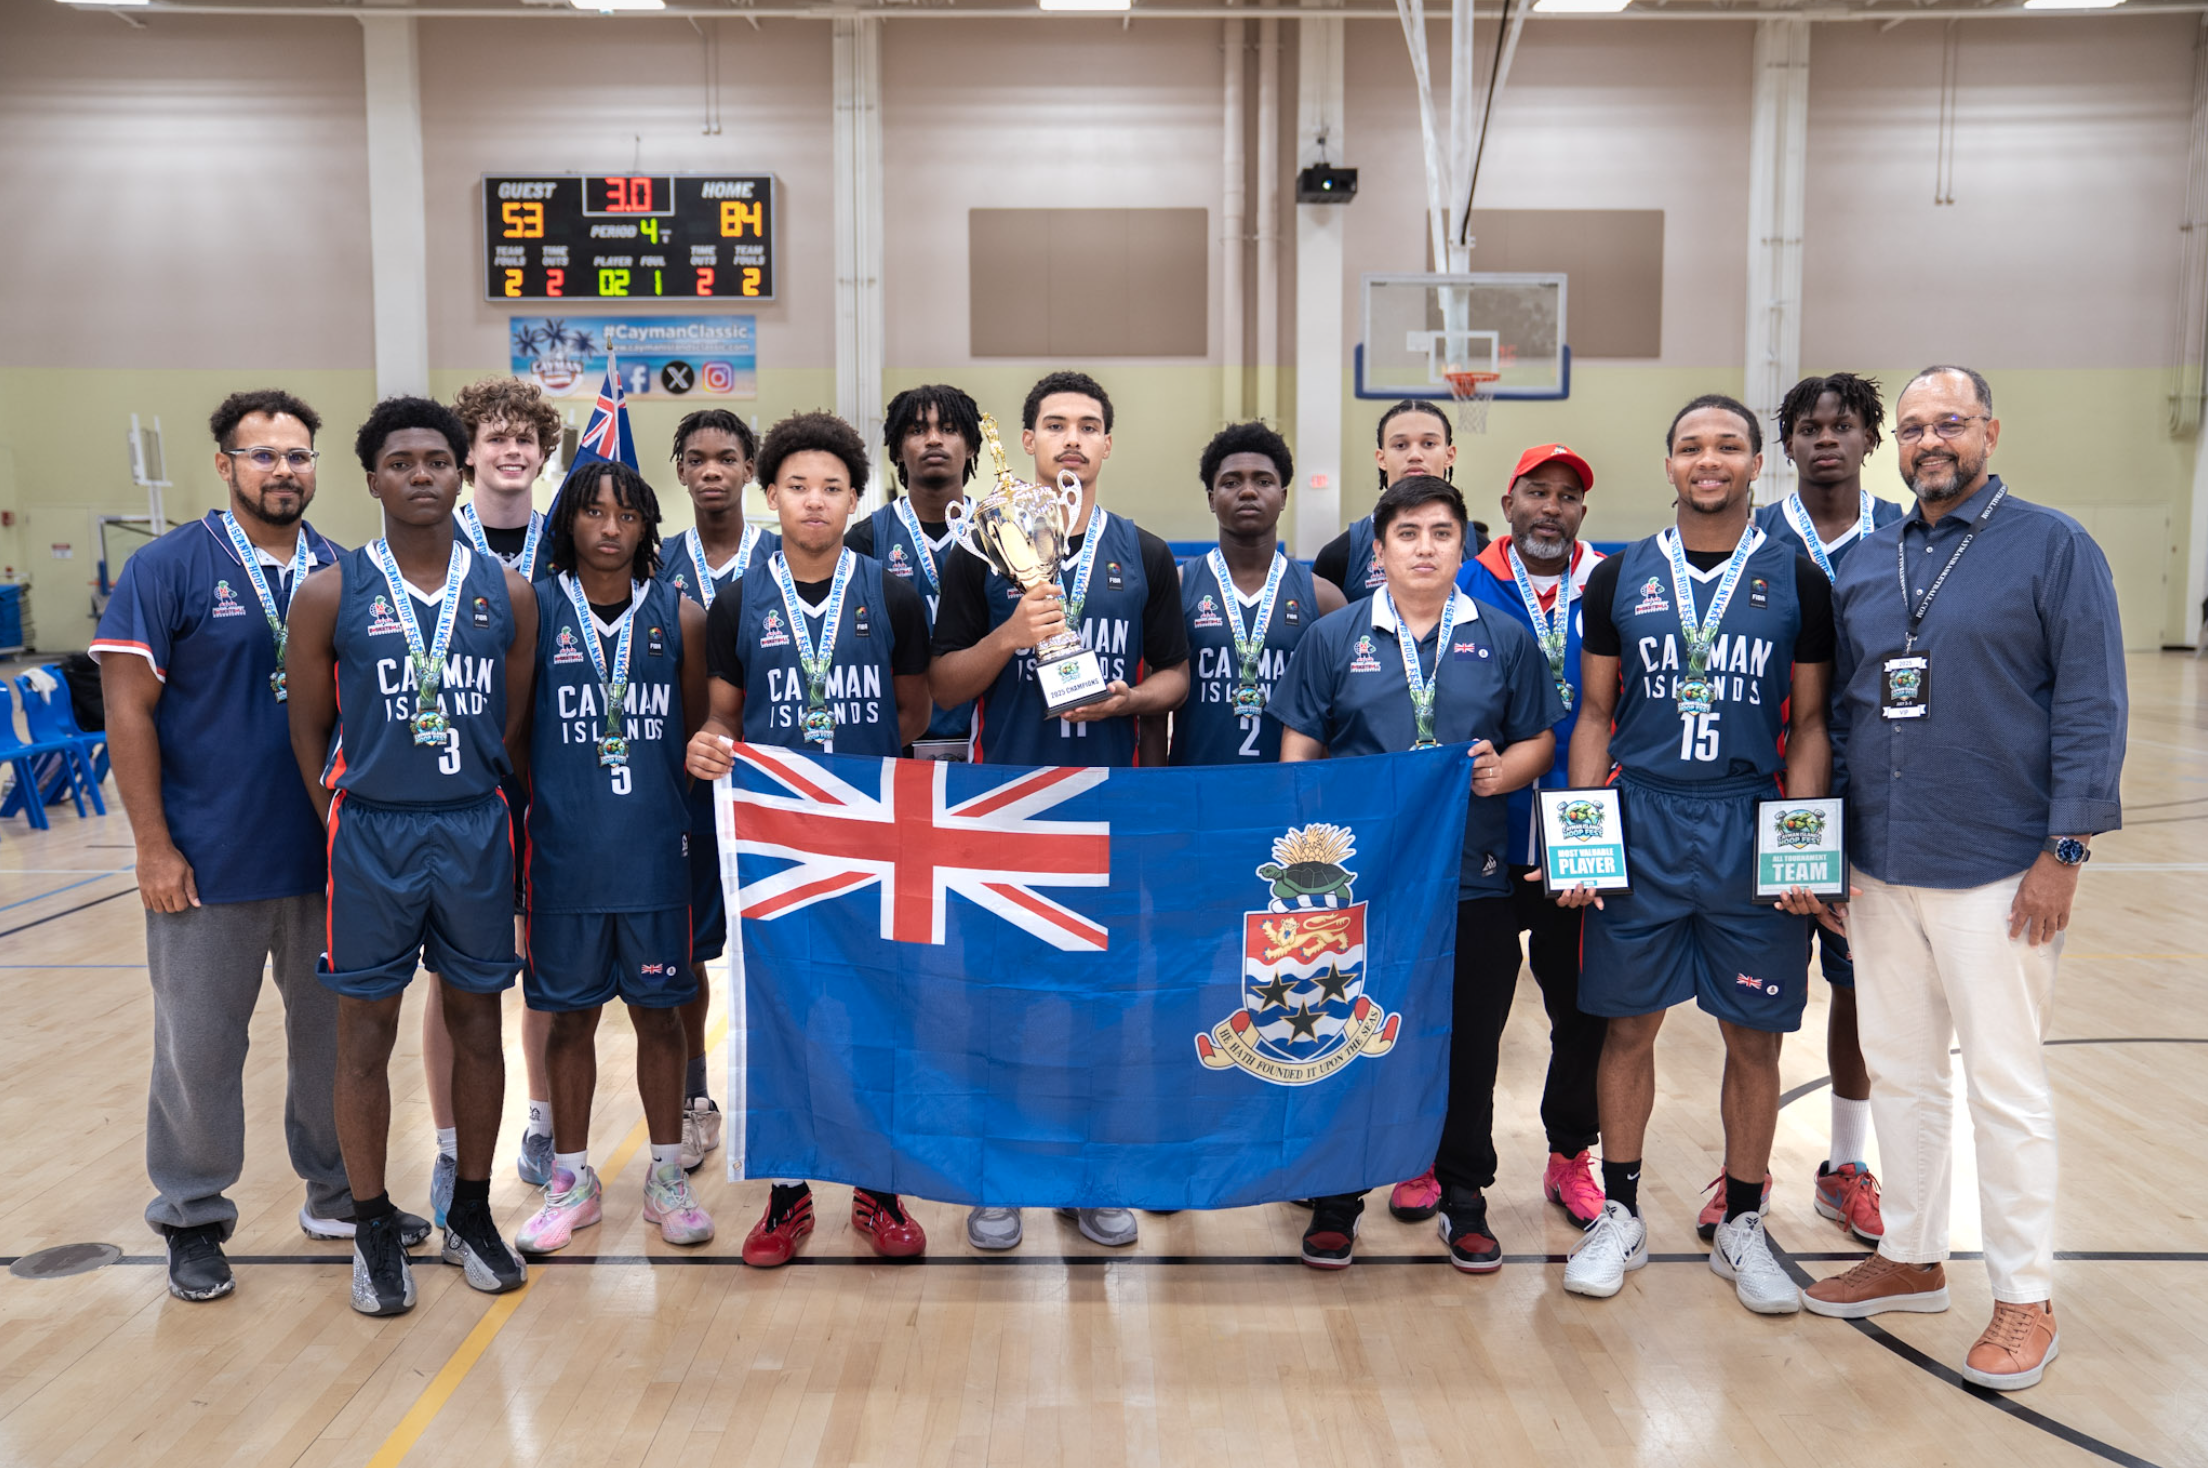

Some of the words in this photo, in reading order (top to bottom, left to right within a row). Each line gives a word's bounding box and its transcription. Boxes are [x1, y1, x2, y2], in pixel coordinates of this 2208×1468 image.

[498, 182, 556, 199] GUEST
[604, 176, 652, 212] 3.0
[702, 181, 755, 198] HOME
[502, 202, 544, 238] 53
[590, 225, 638, 238] PERIOD
[640, 217, 658, 244] 4
[720, 201, 762, 237] 84
[494, 255, 526, 266] FOULS
[495, 246, 525, 256] TEAM
[541, 255, 569, 266] OUTS
[542, 246, 568, 256] TIME
[593, 256, 633, 267] PLAYER
[640, 256, 666, 267] FOUL
[690, 245, 717, 255] TIME
[690, 255, 717, 266] OUTS
[733, 255, 765, 266] FOULS
[734, 245, 764, 255] TEAM
[504, 269, 524, 297] 2
[546, 268, 564, 297] 2
[598, 269, 630, 296] 02
[654, 269, 662, 296] 1
[696, 267, 715, 296] 2
[742, 267, 761, 296] 2
[603, 324, 748, 342] #CaymanClassic
[230, 527, 255, 563] ISLANDS
[250, 564, 266, 590] HOOP
[523, 535, 536, 573] ISLANDS
[1082, 528, 1098, 563] ISLANDS
[1671, 538, 1684, 574] ISLANDS
[383, 555, 405, 596] ISLANDS
[397, 597, 413, 625] HOOP
[781, 567, 797, 607] ISLANDS
[791, 608, 805, 633] HOOP
[829, 578, 844, 618] ISLANDS
[1677, 576, 1690, 600] HOOP
[1705, 590, 1730, 628] CAYMAN
[1723, 550, 1746, 587] ISLANDS
[432, 617, 452, 658] CAYMAN
[443, 573, 461, 615] ISLANDS
[578, 605, 596, 646] ISLANDS
[614, 646, 628, 685] CAYMAN
[1199, 647, 1294, 680] CAMA
[1402, 641, 1416, 664] HOOP
[1639, 634, 1773, 677] CAMAN
[377, 653, 495, 695] CAMAN
[767, 665, 881, 702] CAMAN
[1050, 689, 1066, 699] 2025
[1066, 678, 1100, 694] CHAMPIONS
[1644, 674, 1760, 705] ISLNDS
[770, 701, 879, 728] ISLNDS
[562, 718, 664, 744] ISLNDS
[1239, 714, 1260, 756] 2
[1681, 712, 1720, 761] 15
[438, 728, 461, 775] 3
[611, 766, 632, 795] 5
[1557, 849, 1578, 858] MOST
[1578, 848, 1614, 857] VALUABLE
[1558, 857, 1616, 875] PLAYER
[1784, 854, 1827, 862] TOURNAMENT
[1772, 862, 1828, 882] TEAM
[1218, 1028, 1231, 1045] HE
[1229, 1041, 1254, 1066] HATH
[1256, 1061, 1303, 1080] FOUNDED
[1306, 1068, 1316, 1079] IT
[1319, 1055, 1345, 1074] UPON
[1343, 1037, 1363, 1057] THE
[1361, 1010, 1379, 1037] SEAS
